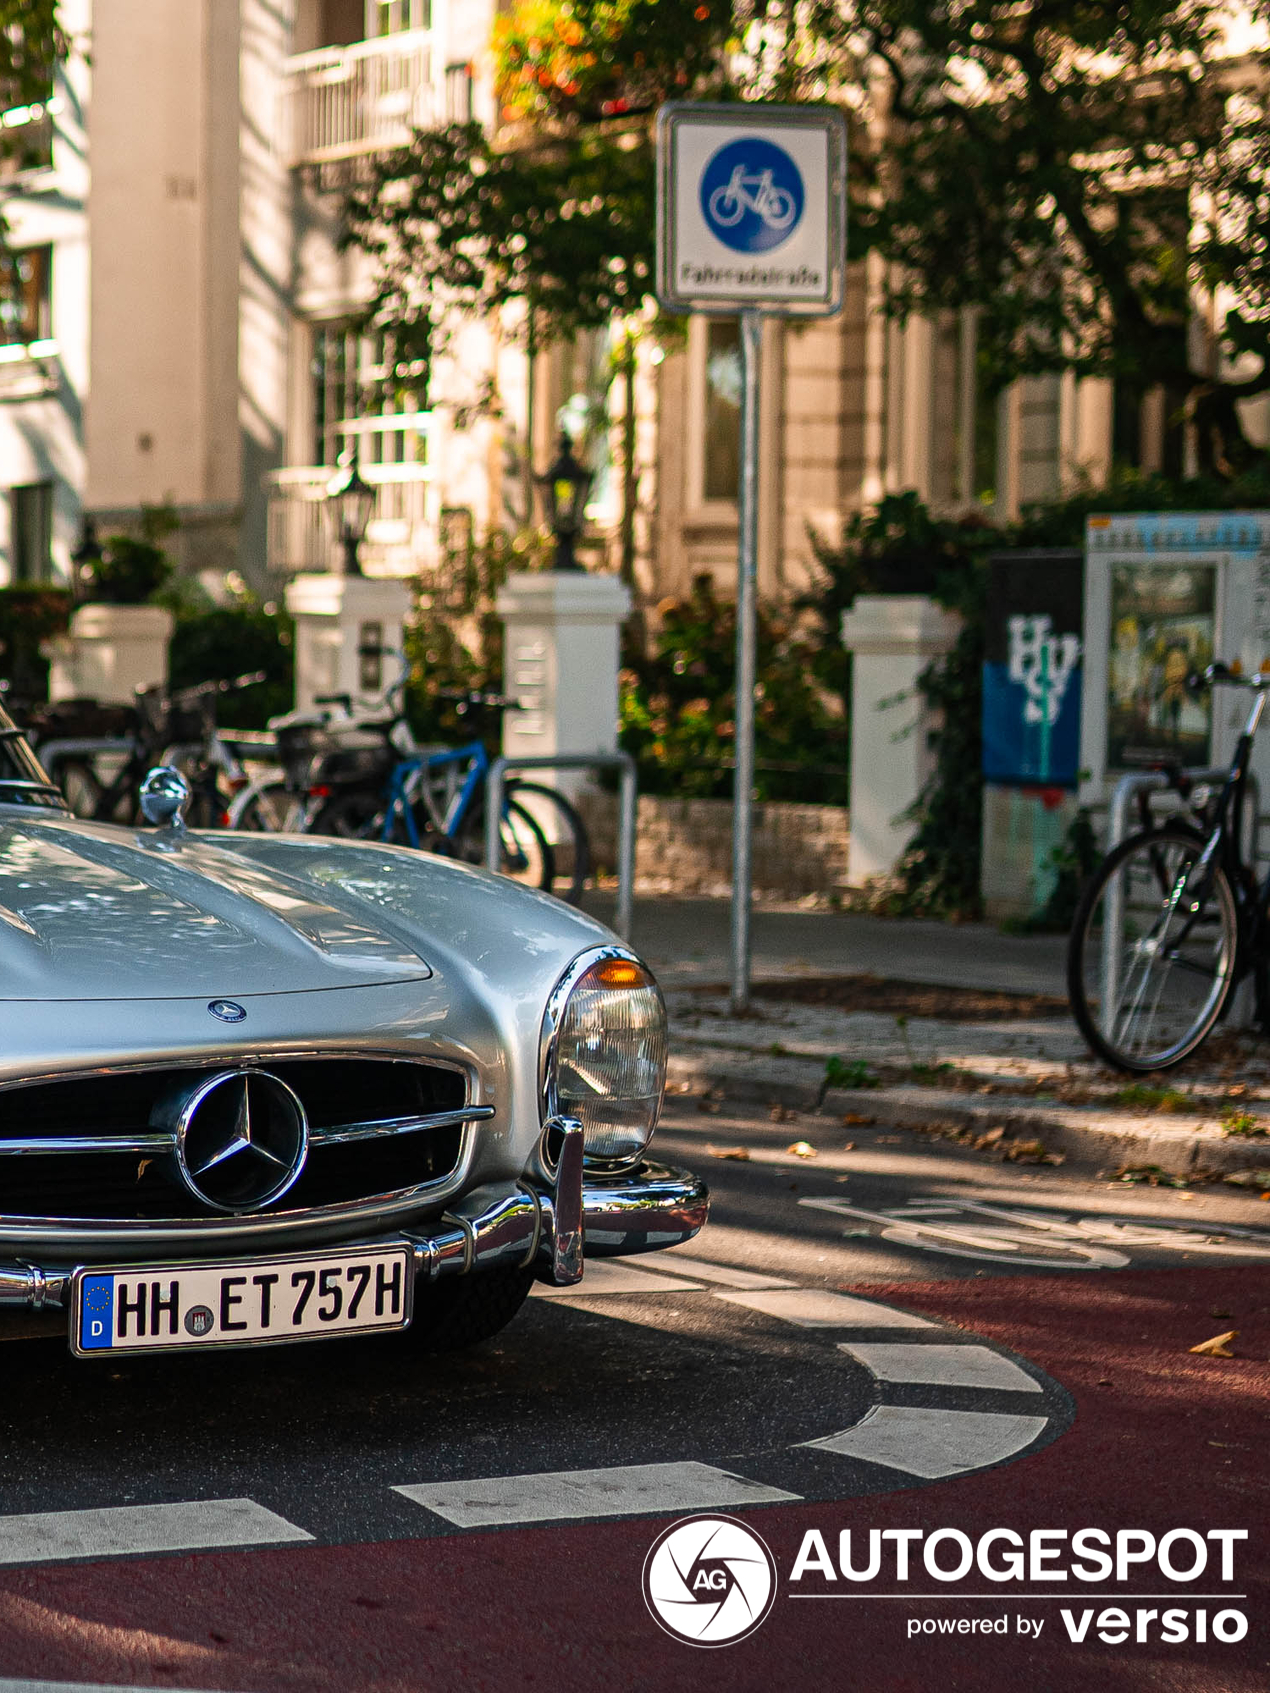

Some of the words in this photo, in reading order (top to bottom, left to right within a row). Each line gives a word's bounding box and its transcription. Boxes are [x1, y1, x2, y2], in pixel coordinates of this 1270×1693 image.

[117, 1280, 180, 1338] HH
[220, 1273, 279, 1332] ET
[291, 1262, 402, 1325] 757H
[91, 1320, 103, 1337] D
